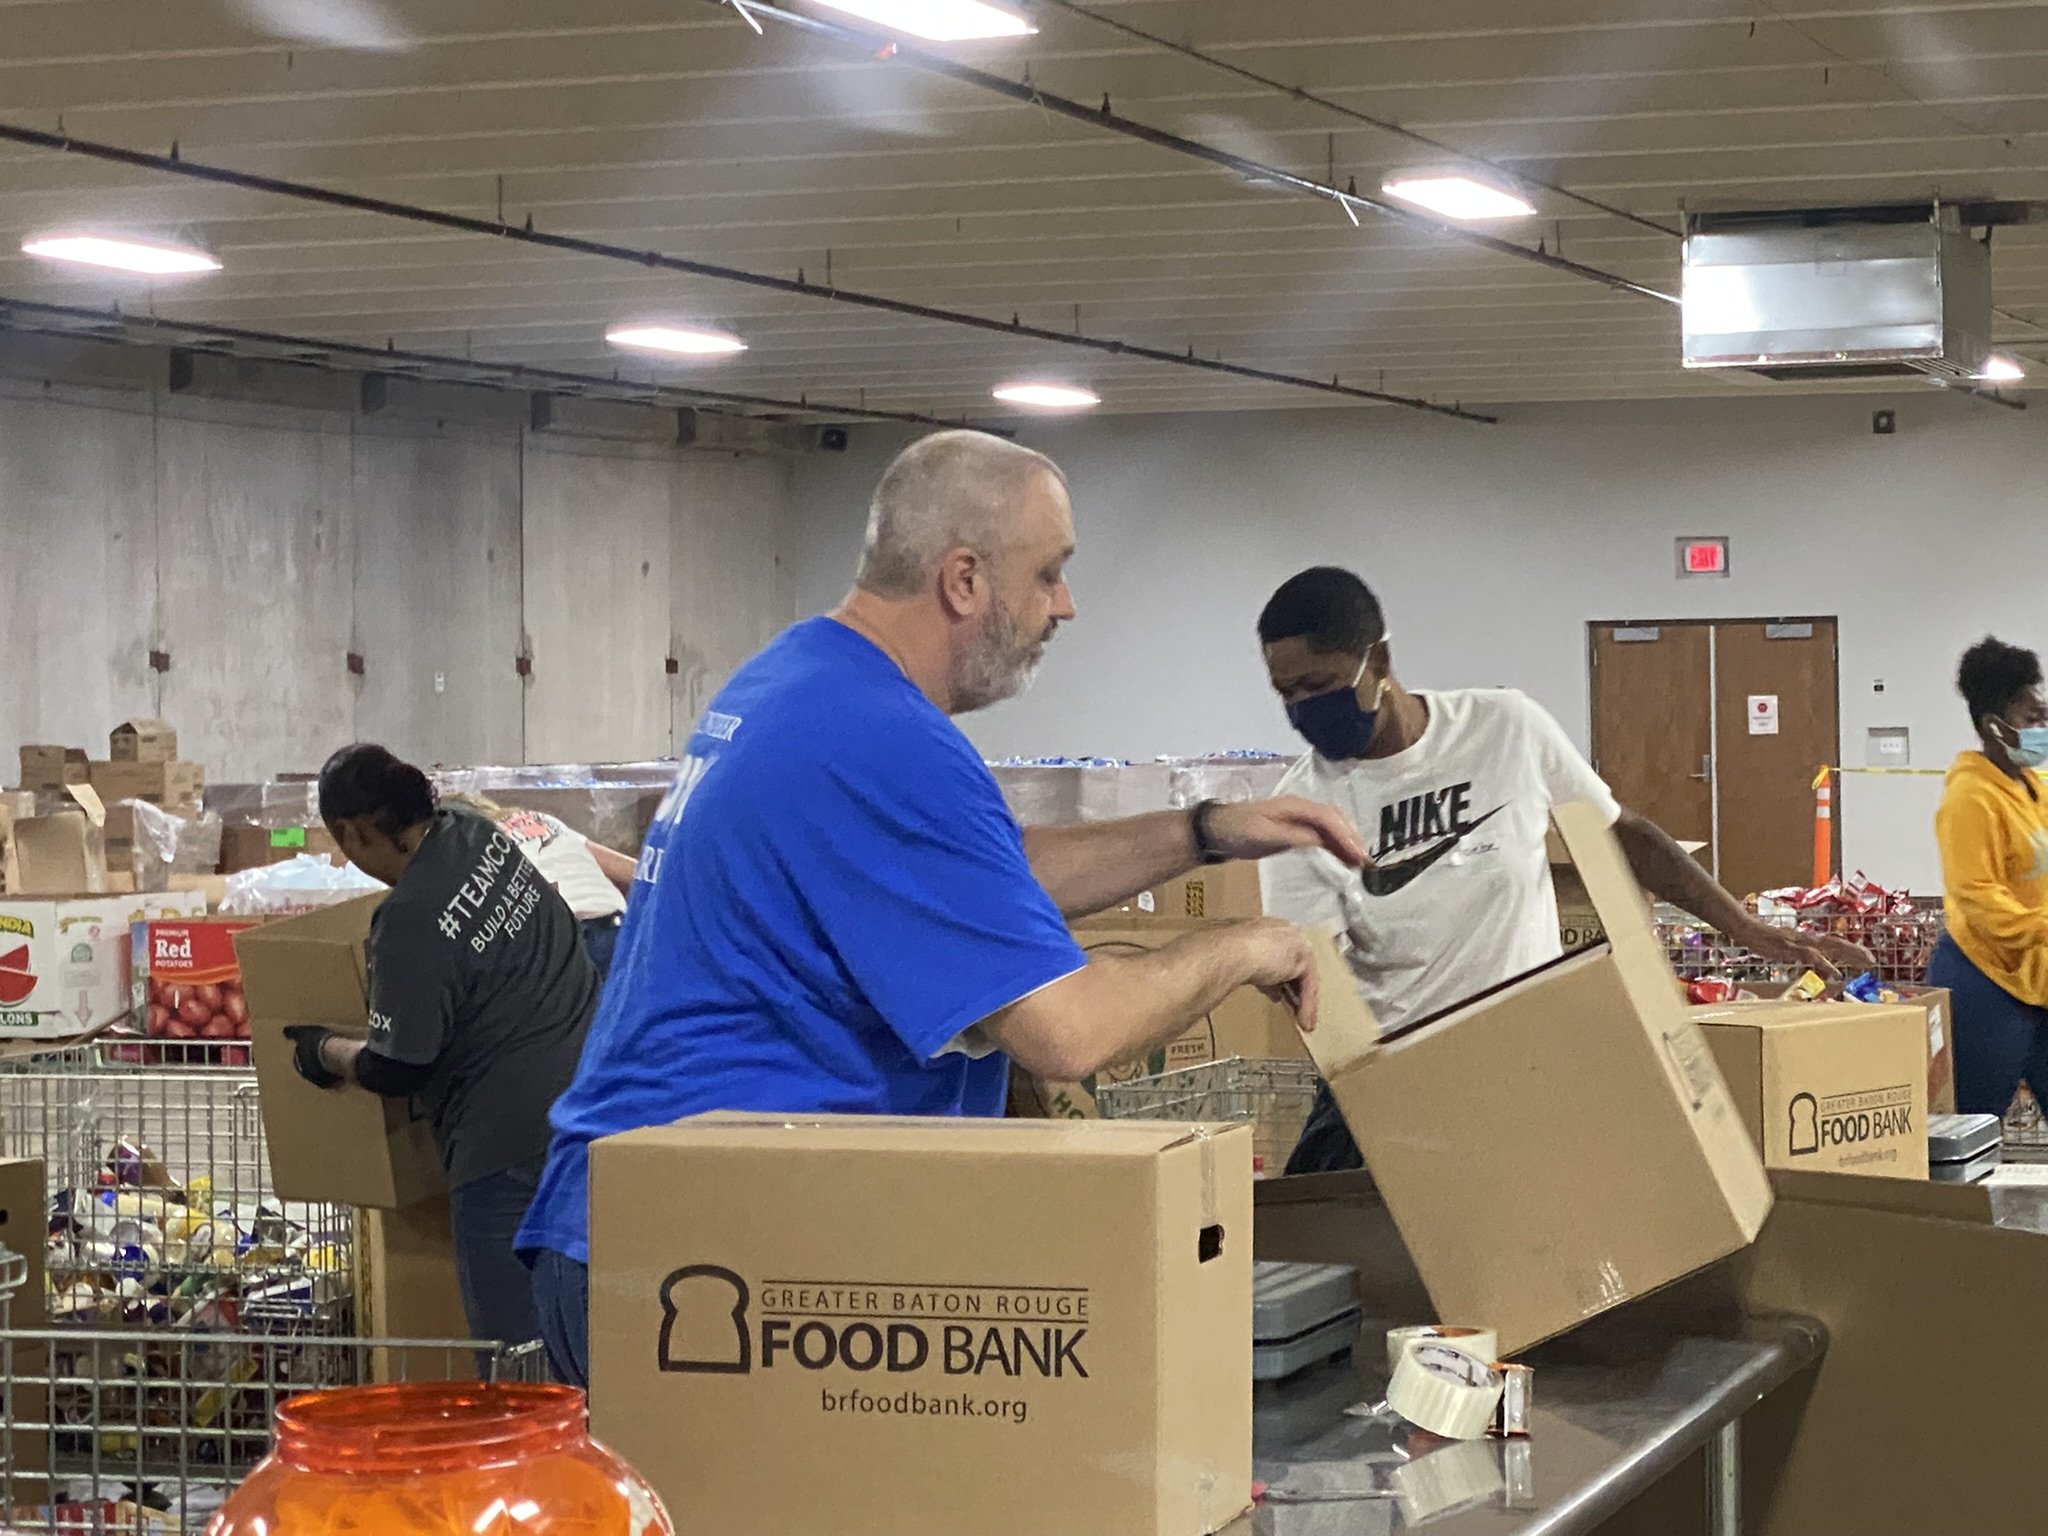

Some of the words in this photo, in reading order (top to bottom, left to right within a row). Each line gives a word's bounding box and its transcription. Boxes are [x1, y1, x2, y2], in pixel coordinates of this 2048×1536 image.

[1378, 781, 1471, 853] NIKE
[438, 831, 514, 940] #TEAMCO
[506, 855, 535, 900] BETTE
[500, 894, 516, 912] A
[504, 884, 542, 940] FUTURE
[155, 938, 192, 959] Red
[471, 905, 506, 953] BUILD
[155, 960, 193, 968] POTATOES
[1821, 1113, 1870, 1147] FOOD
[1873, 1105, 1912, 1140] BANK
[761, 1288, 878, 1310] GREATER
[893, 1292, 981, 1313] BATON
[996, 1295, 1088, 1316] ROUGE
[761, 1320, 929, 1372] FOOD
[944, 1325, 1089, 1378] BANK
[821, 1388, 1027, 1423] brfoodbank.org
